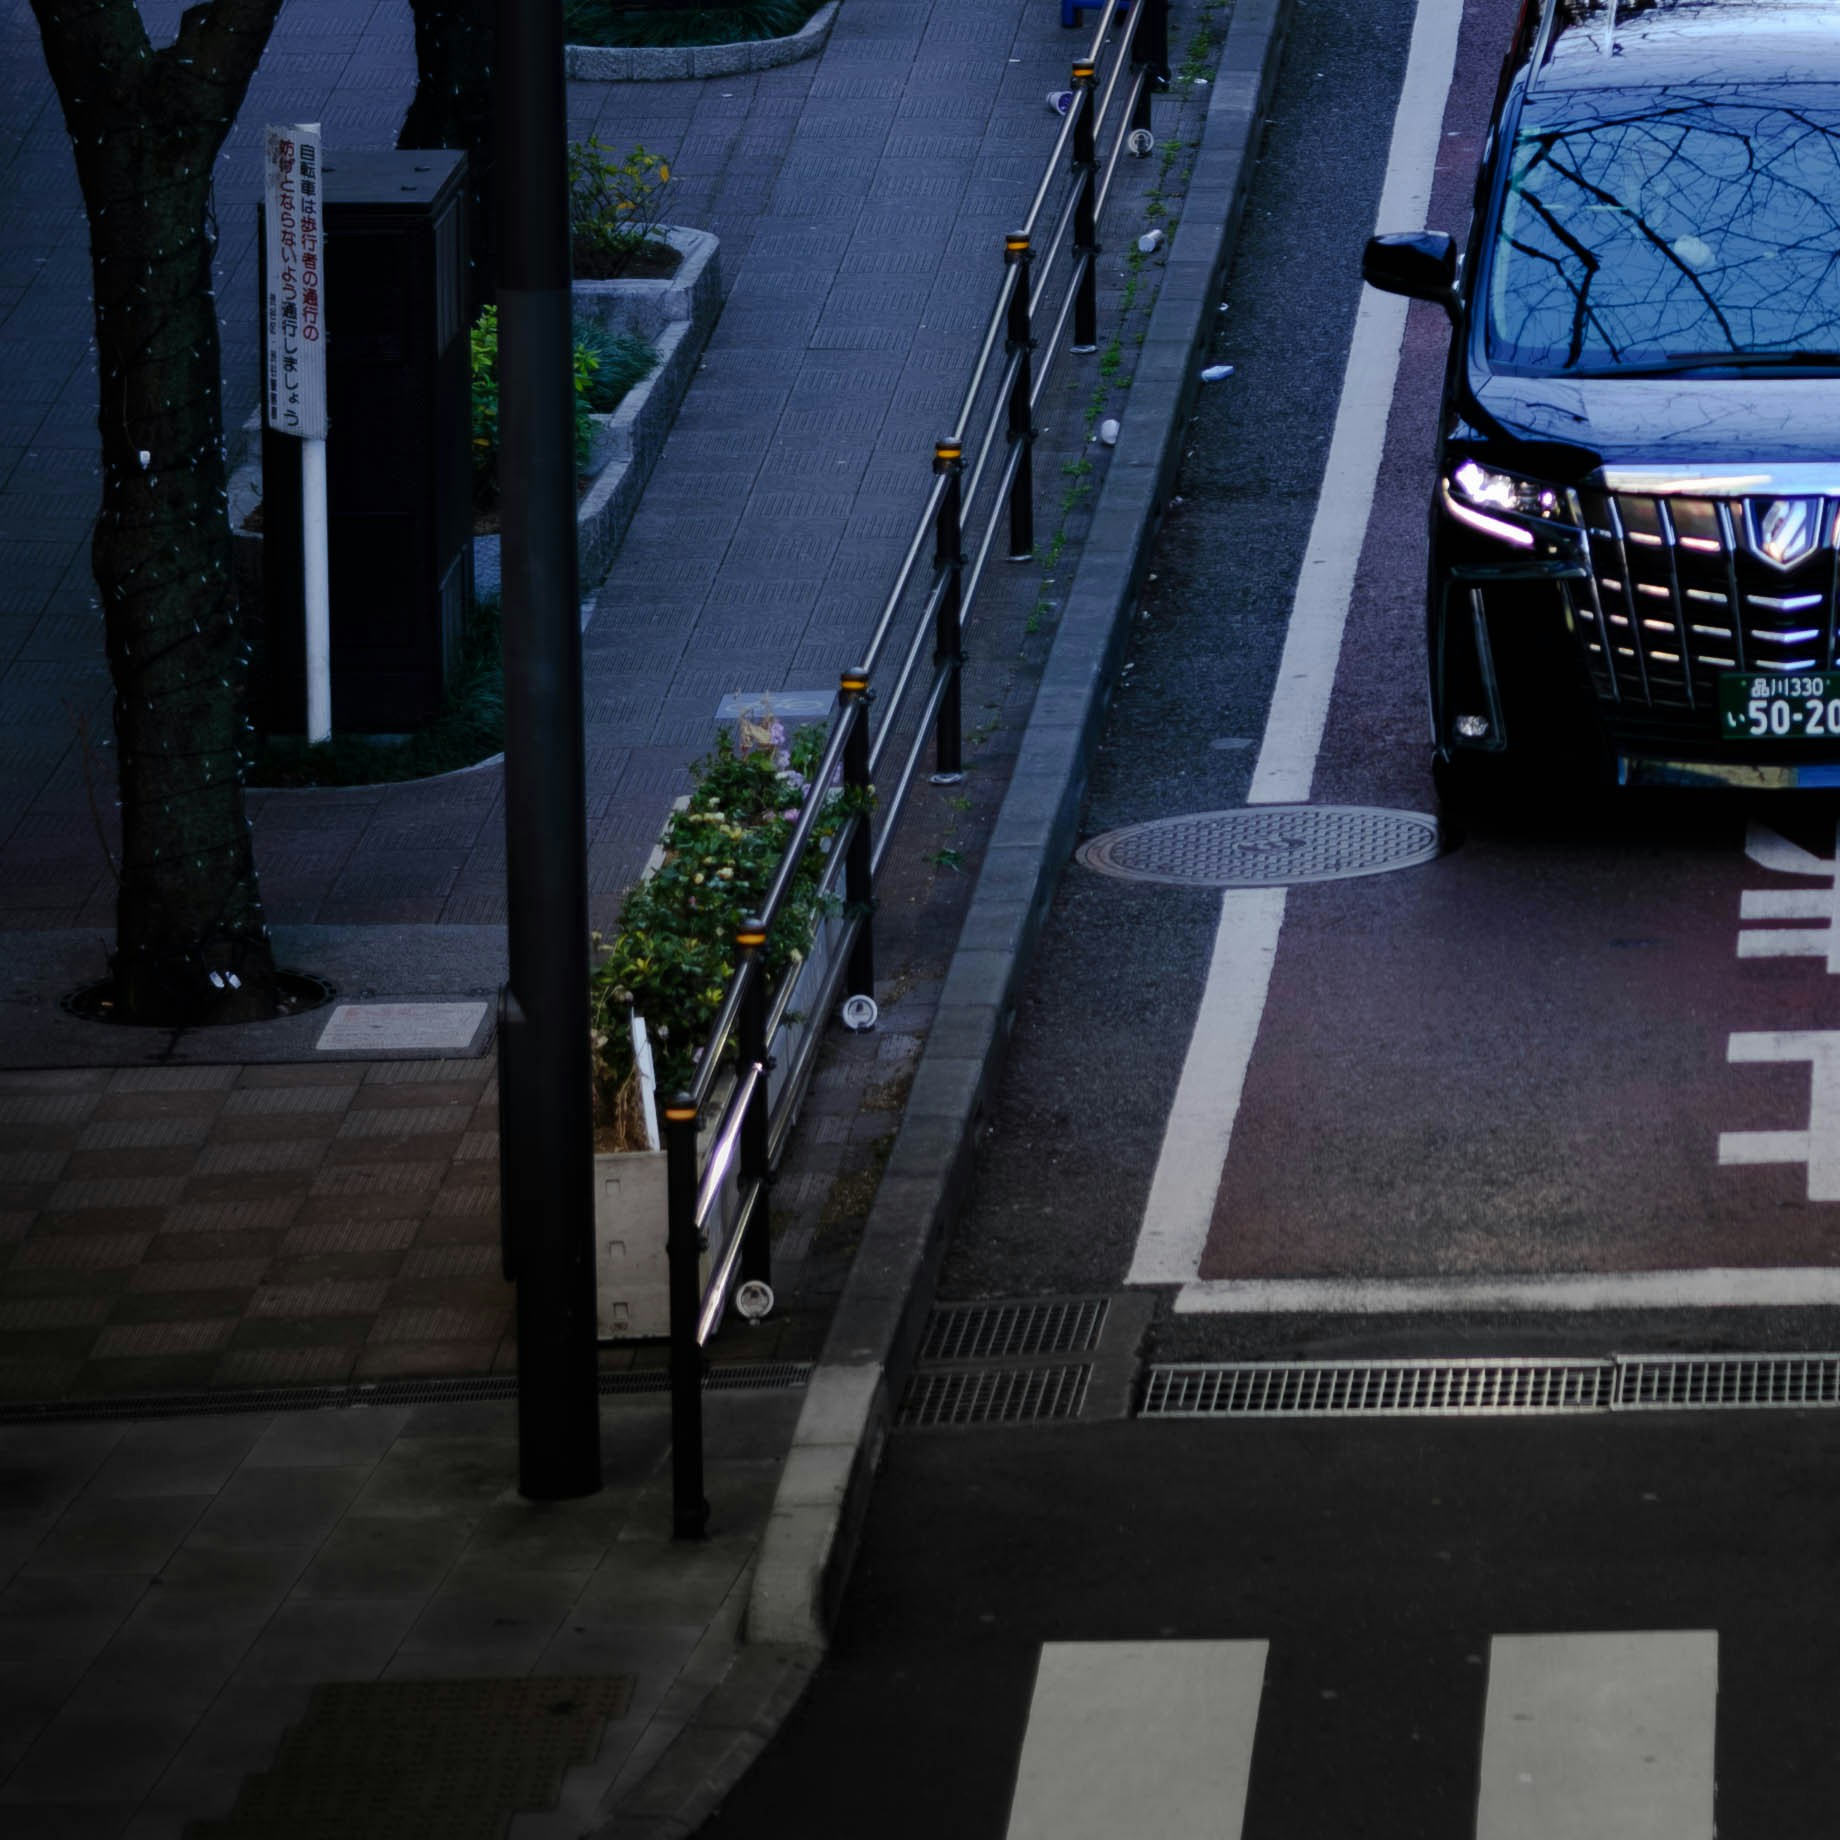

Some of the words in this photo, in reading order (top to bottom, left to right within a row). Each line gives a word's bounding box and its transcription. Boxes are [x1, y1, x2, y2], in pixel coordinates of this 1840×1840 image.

[300, 143, 319, 342] 自転車は歩行者の通行の
